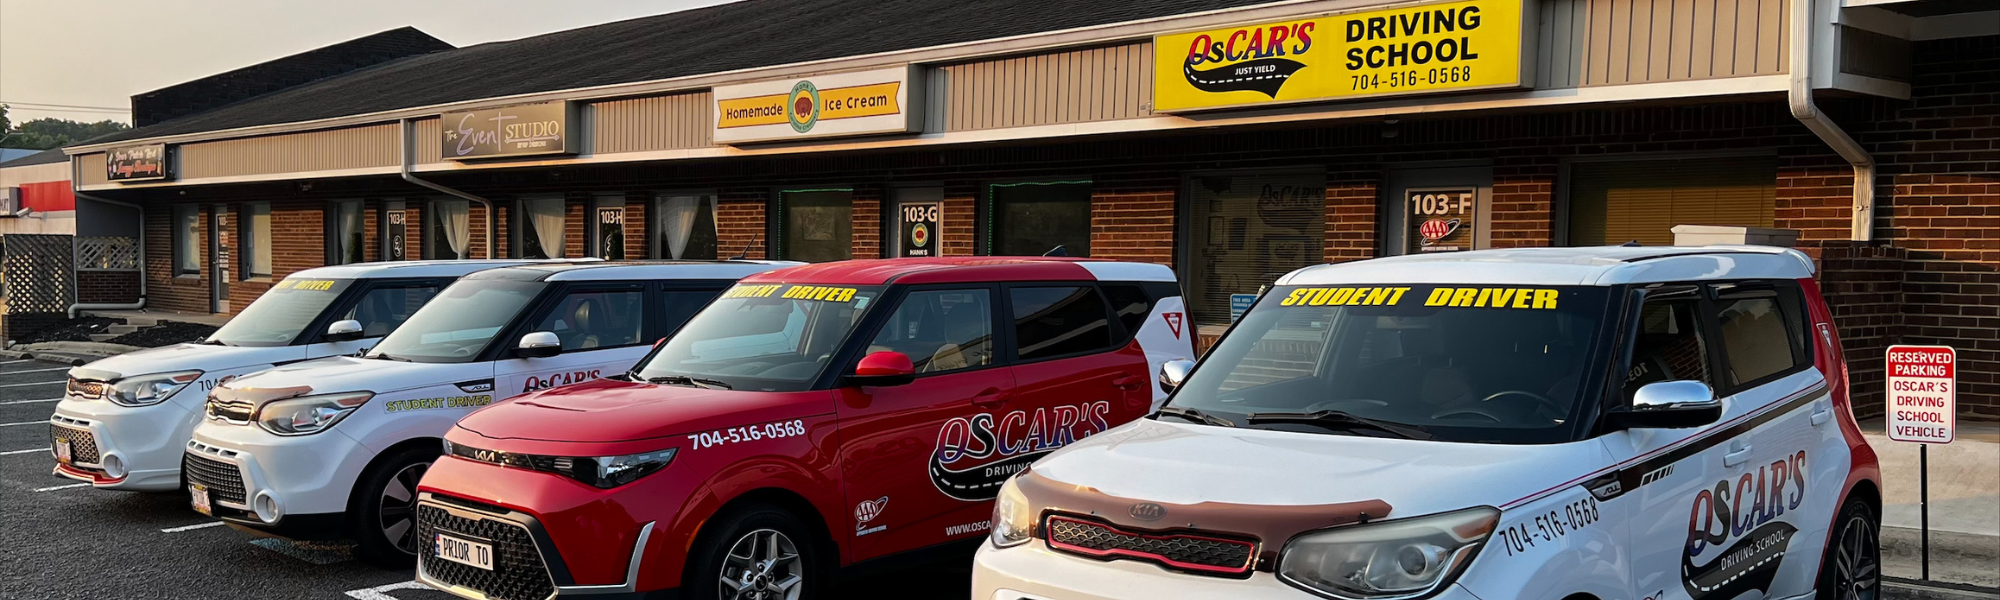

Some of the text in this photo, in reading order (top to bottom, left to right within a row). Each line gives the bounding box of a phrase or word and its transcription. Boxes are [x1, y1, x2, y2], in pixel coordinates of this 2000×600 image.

[1345, 6, 1481, 42] DRIVING
[1345, 37, 1479, 70] SCHOOL
[1234, 64, 1276, 76] JUST YIELD
[1351, 66, 1471, 91] 704-516-0568
[726, 94, 888, 120] Homemade Ice Cream
[456, 112, 518, 155] Event
[505, 121, 560, 140] STUDIO
[1411, 193, 1472, 215] 103-F
[601, 211, 623, 225] 103-H
[904, 206, 937, 223] 103-G
[781, 285, 857, 302] DRIVER
[1280, 287, 1559, 309] STUDENT DRIVER
[1889, 352, 1952, 364] RESERVED
[1895, 364, 1946, 376] PARKING
[1893, 380, 1948, 393] OSCAR'S
[386, 395, 492, 412] STUDENT DRIVER
[1896, 395, 1945, 408] DRIVING
[1896, 410, 1945, 423] SCHOOL
[687, 419, 806, 450] 704-516-0568
[1896, 425, 1946, 438] VEHICLE
[1131, 504, 1160, 517] KIA
[1499, 496, 1600, 557] 704-516-0568
[443, 537, 489, 566] PRIOR TO
[1720, 529, 1785, 571] DRIVING SCHOOL
